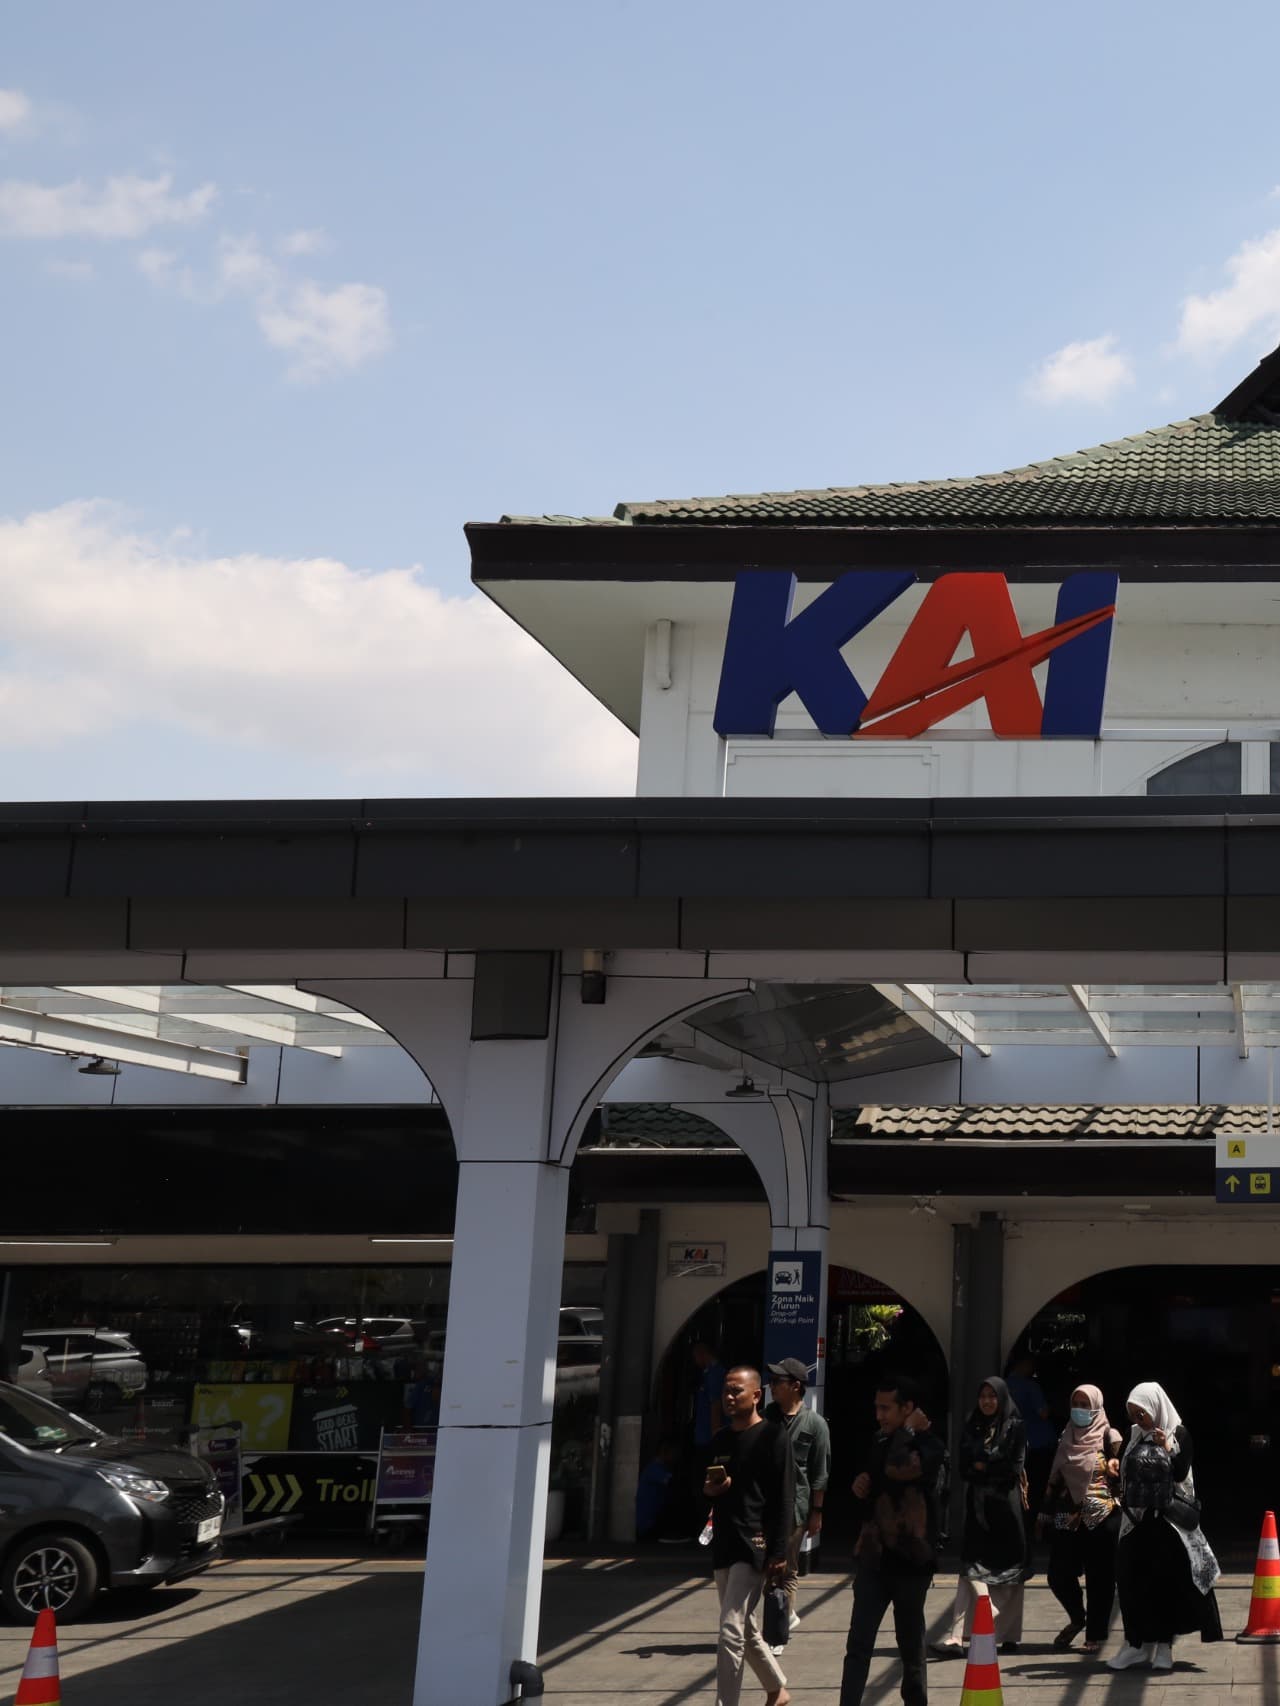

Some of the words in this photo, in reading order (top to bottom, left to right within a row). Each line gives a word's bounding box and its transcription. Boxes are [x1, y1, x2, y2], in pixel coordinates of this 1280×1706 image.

[713, 571, 1121, 740] KAI
[1232, 1144, 1241, 1153] A
[771, 1294, 793, 1304] Zona
[795, 1294, 815, 1303] Naik
[316, 1424, 359, 1451] START
[316, 1478, 377, 1503] Troll
